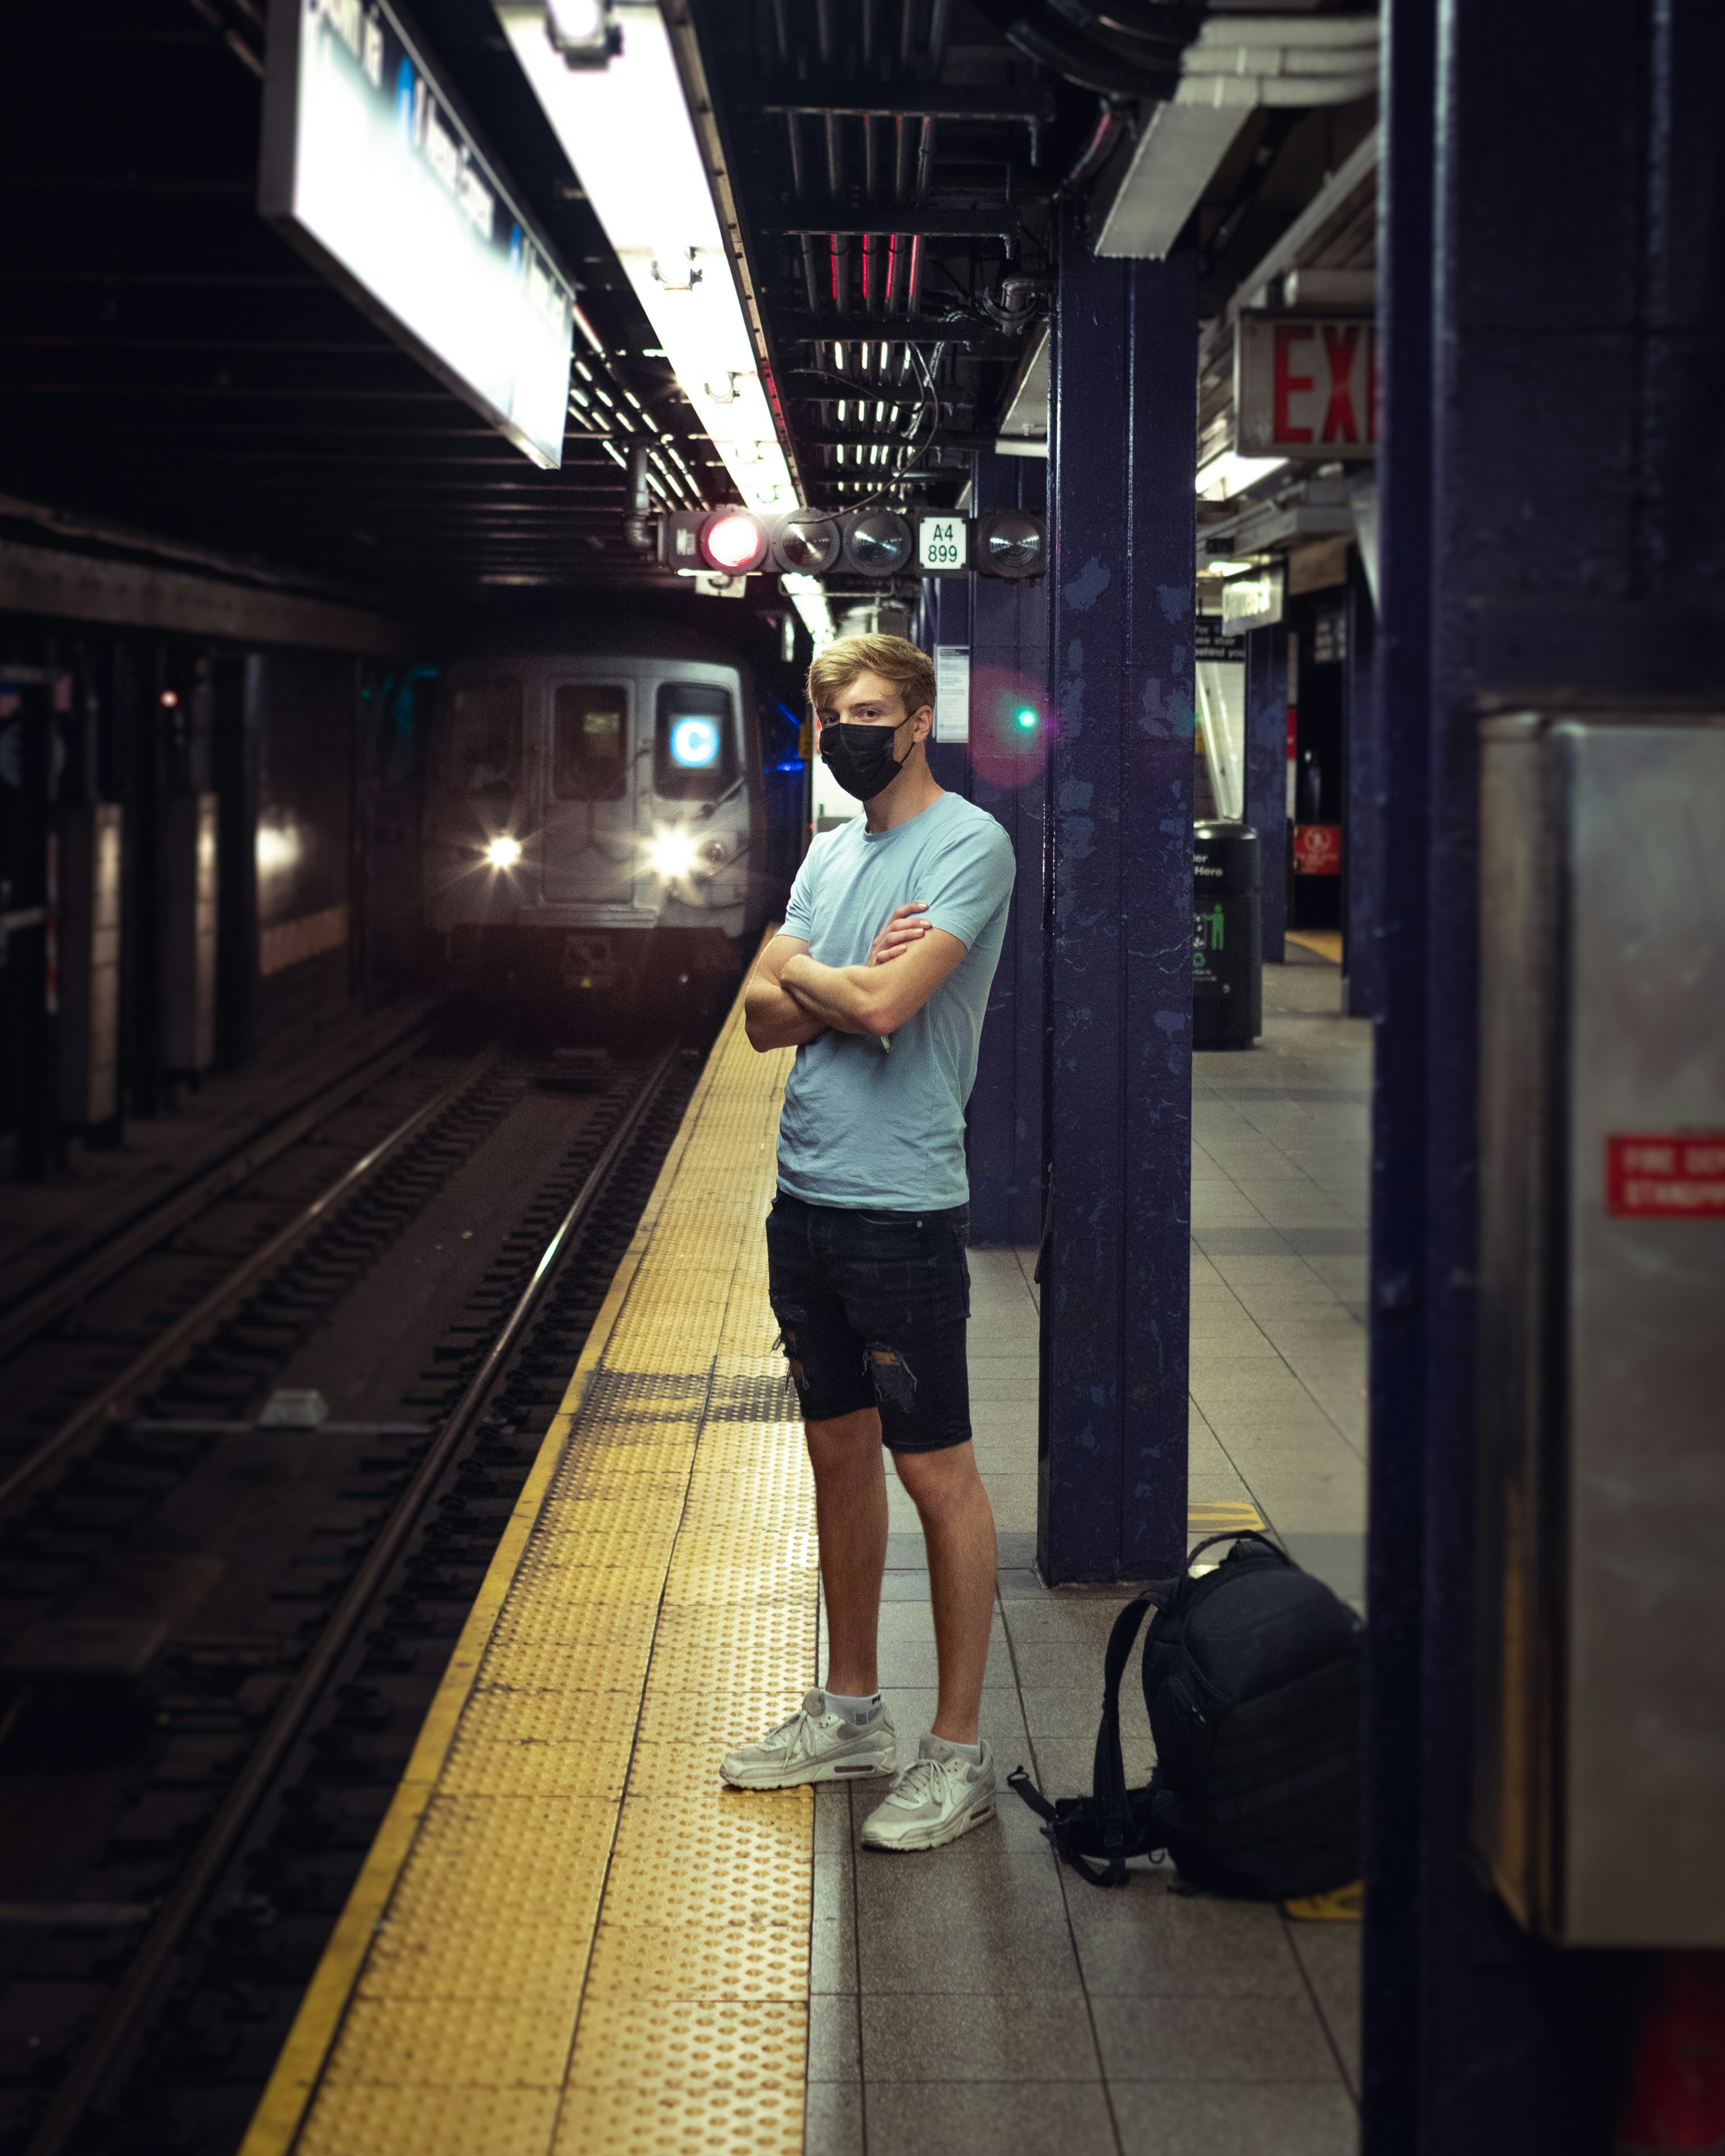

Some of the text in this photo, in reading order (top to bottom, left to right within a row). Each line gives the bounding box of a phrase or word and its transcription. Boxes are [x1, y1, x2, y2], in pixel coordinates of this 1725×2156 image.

[933, 524, 954, 541] A4
[928, 544, 957, 563] 899
[676, 722, 711, 762] C
[1195, 866, 1223, 876] Here
